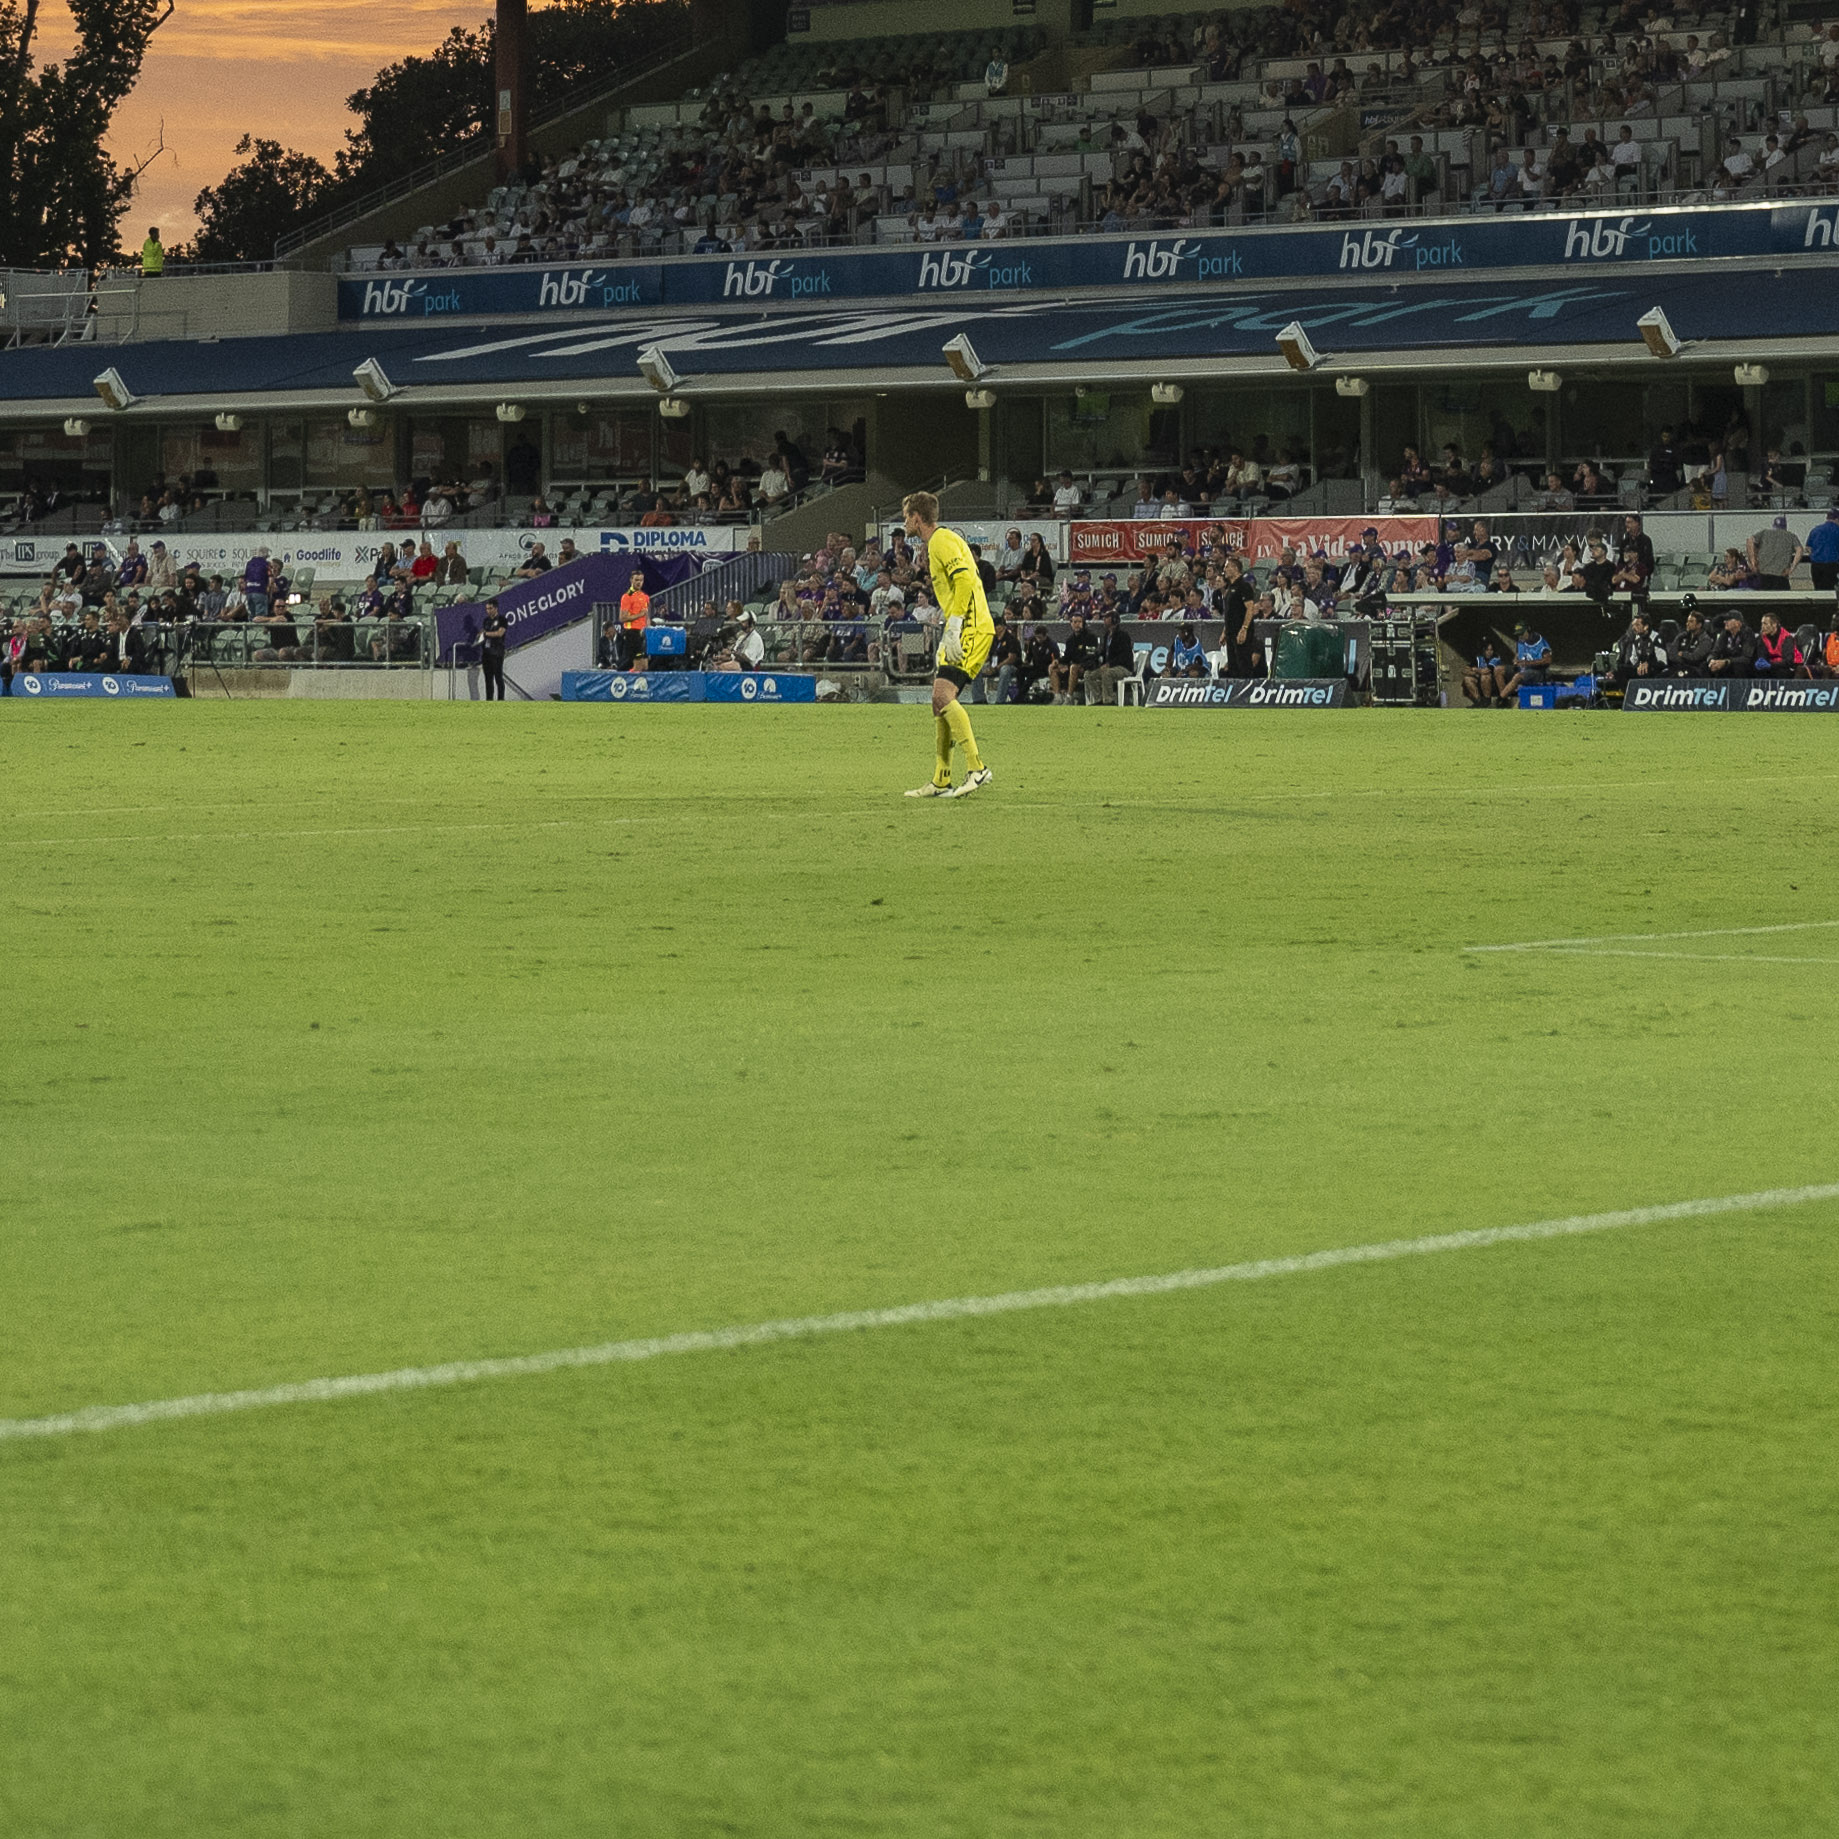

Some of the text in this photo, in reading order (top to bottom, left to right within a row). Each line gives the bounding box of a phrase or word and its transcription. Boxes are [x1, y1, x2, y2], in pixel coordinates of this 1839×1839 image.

[1340, 229, 1463, 270] hbf park
[1564, 217, 1698, 259] hbf park
[723, 260, 831, 299] hbf park
[918, 250, 1032, 290] hbf park
[1124, 239, 1242, 282] hbf park
[363, 279, 460, 316] hbf park
[540, 269, 640, 308] hbf park
[297, 548, 341, 561] Goodlife
[633, 531, 707, 546] DIPLOMA
[1077, 533, 1119, 549] SUMICH
[1156, 683, 1333, 704] DrimTel DrimTel
[1635, 685, 1839, 707] DrimTel DrimTel
